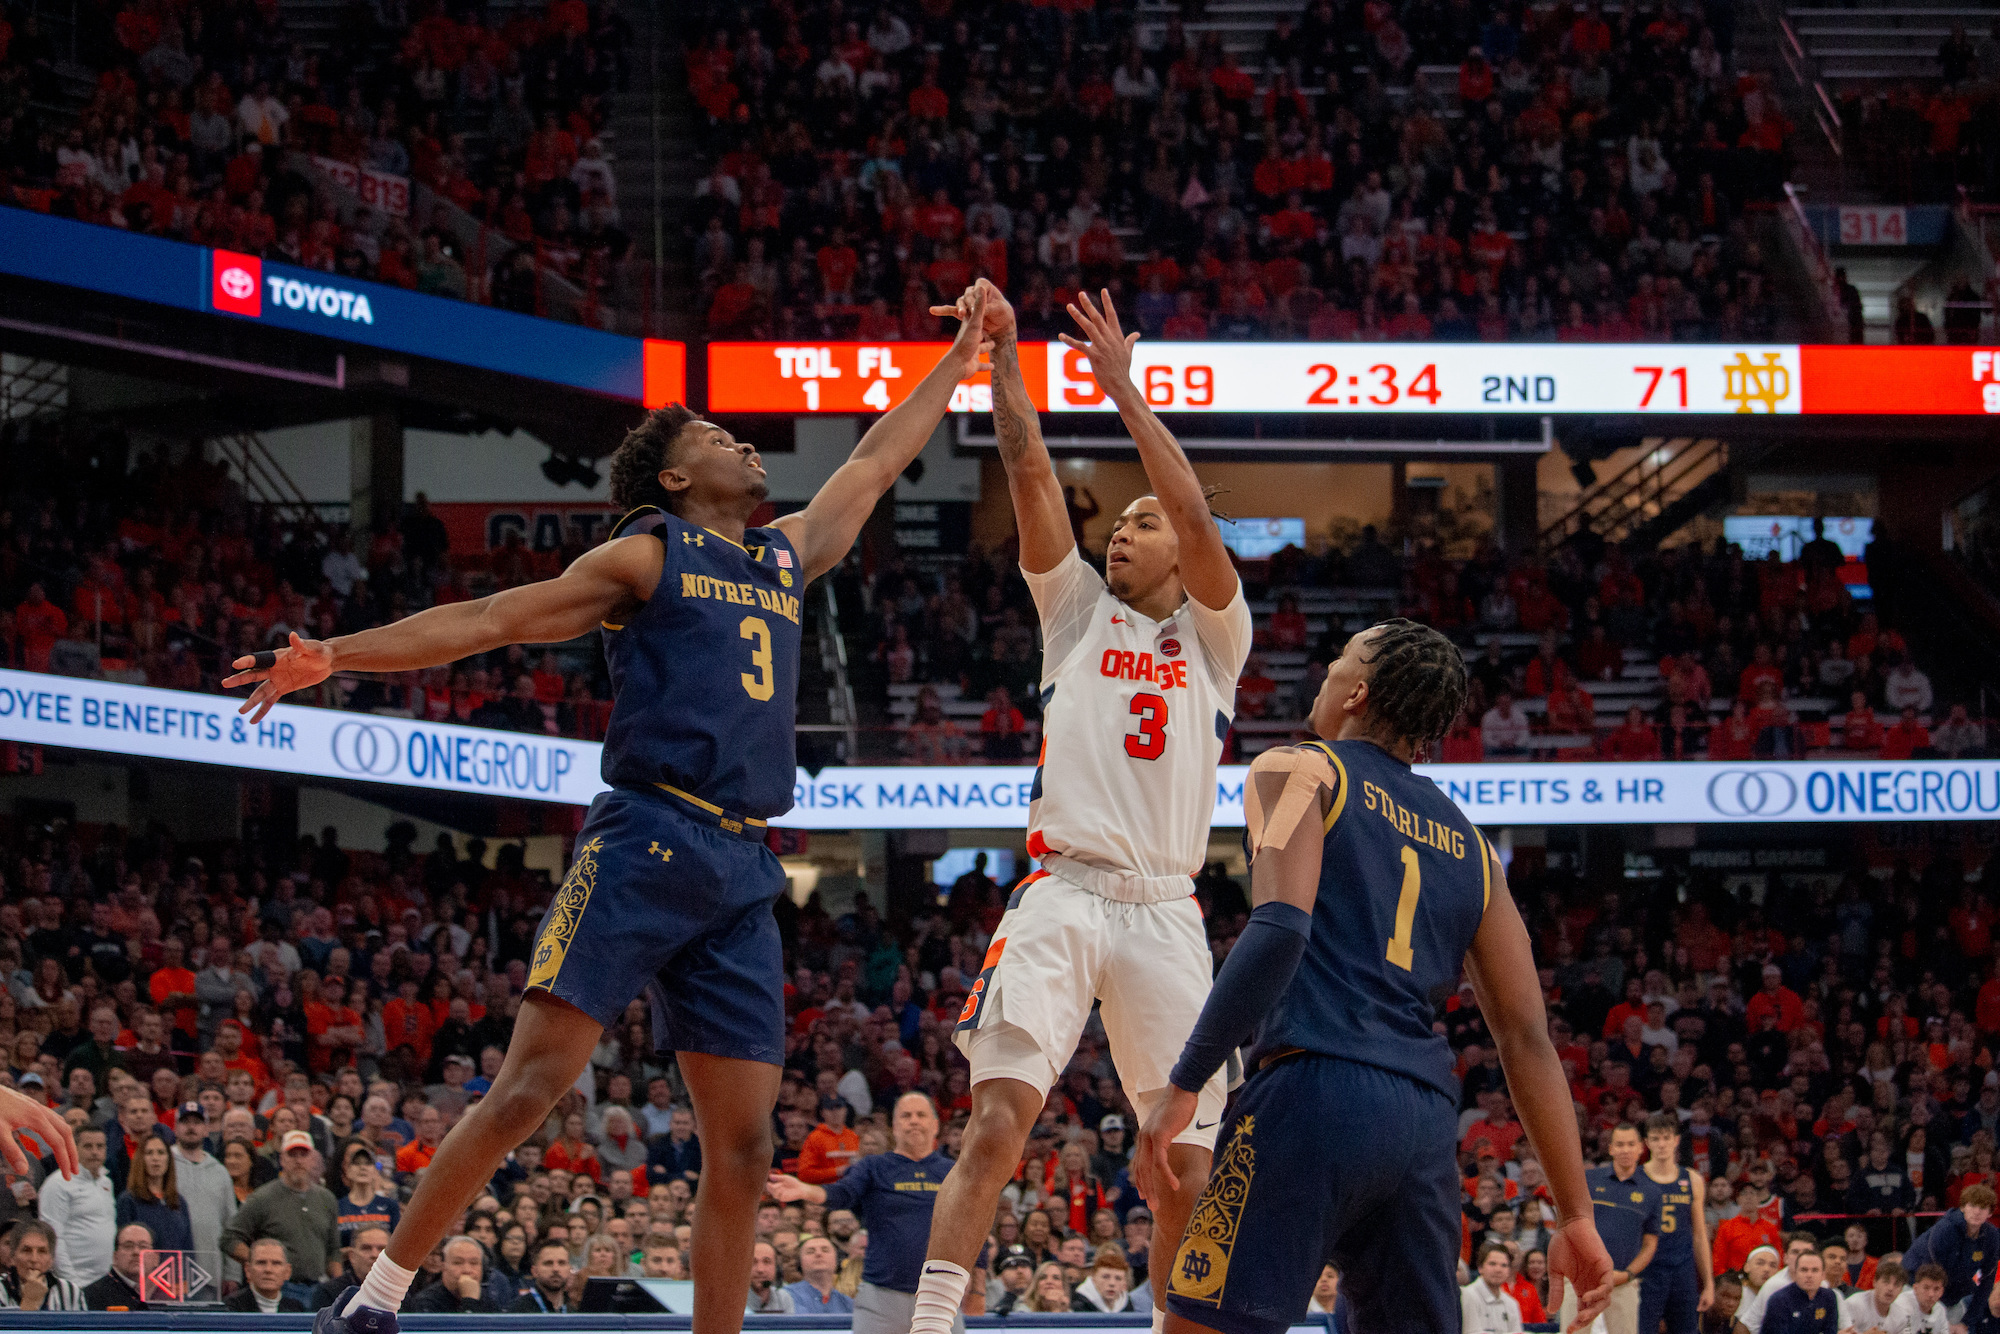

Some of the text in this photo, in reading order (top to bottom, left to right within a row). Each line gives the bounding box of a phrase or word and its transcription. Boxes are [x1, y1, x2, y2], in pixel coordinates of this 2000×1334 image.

[1842, 212, 1903, 240] 314
[267, 275, 374, 325] TOYOTA
[774, 346, 902, 378] TOL FL
[1306, 363, 1442, 405] 2:34
[802, 379, 890, 411] 1 4
[1144, 365, 1214, 406] 69
[1483, 376, 1555, 403] 2ND
[1633, 366, 1688, 410] 71
[681, 573, 800, 626] NOTRE DAME
[739, 616, 775, 701] 3
[82, 698, 221, 742] BENEFITS
[230, 716, 247, 744] &
[258, 719, 296, 751] HR
[1124, 692, 1168, 761] 3
[407, 731, 572, 794] ONEGROUP
[1433, 779, 1664, 804] NEFITS & HR
[1363, 781, 1465, 860] STARLING
[1386, 845, 1421, 972] 1
[1661, 1205, 1677, 1233] 5
